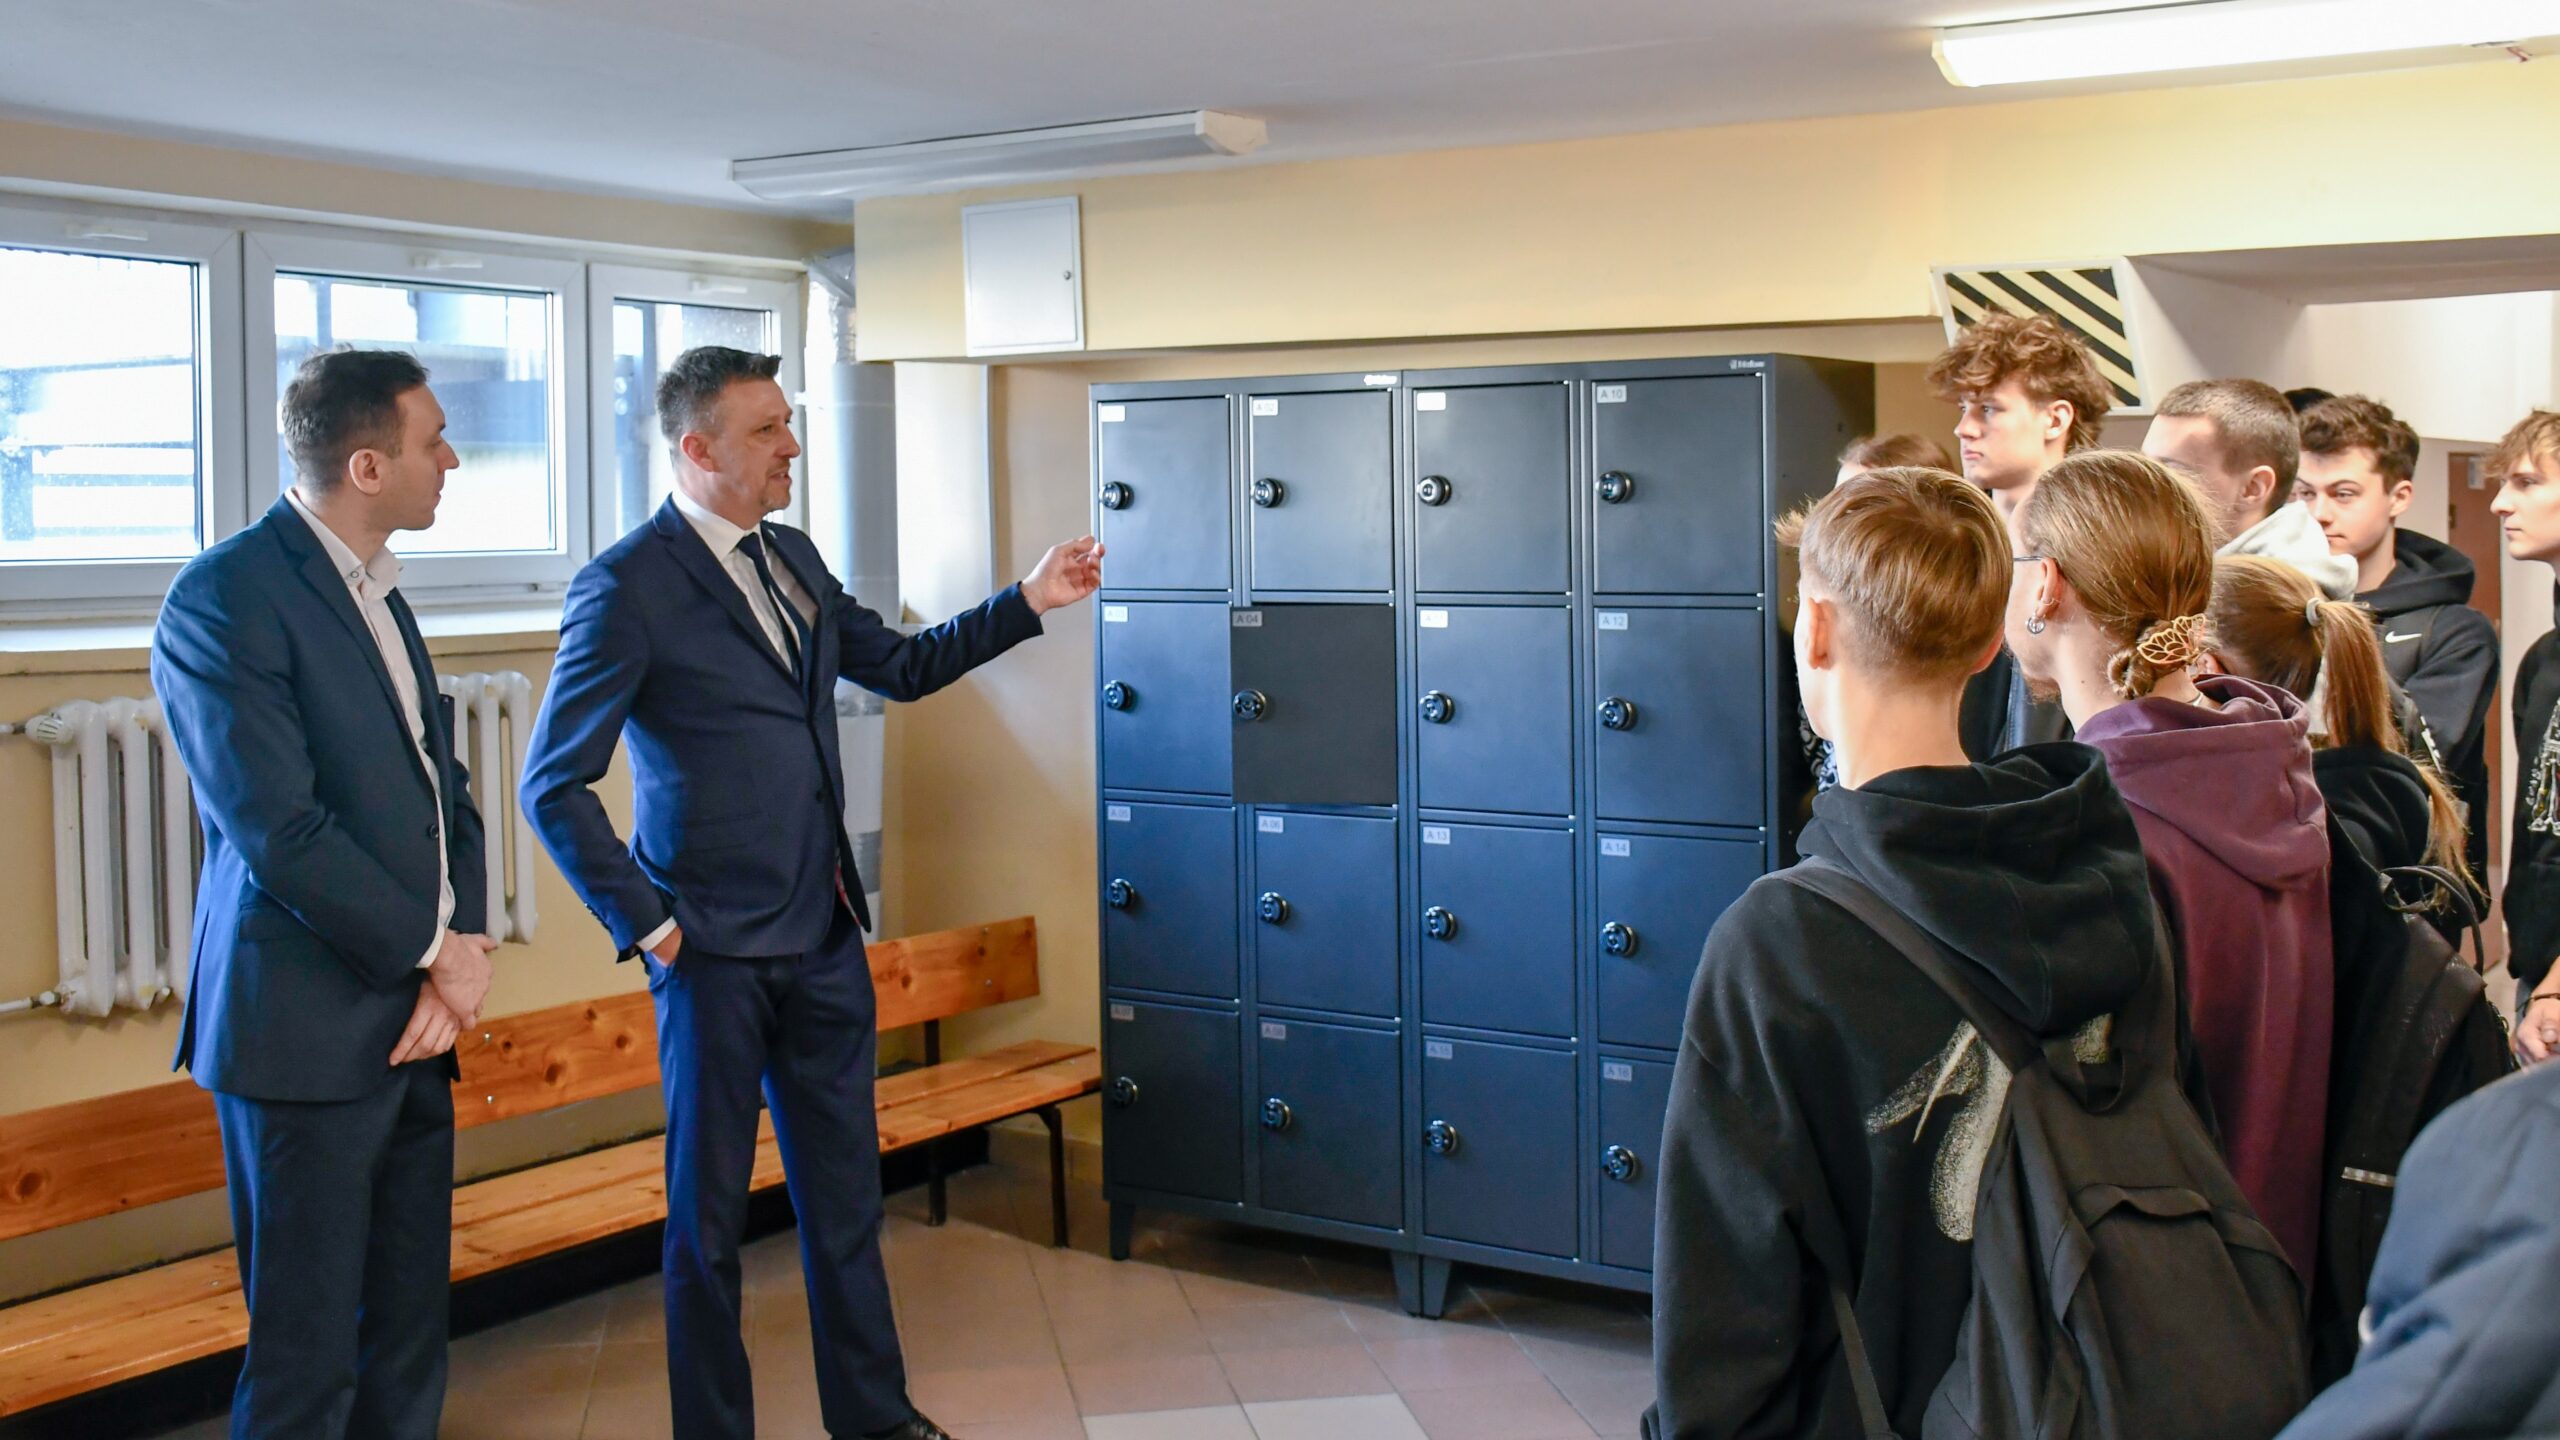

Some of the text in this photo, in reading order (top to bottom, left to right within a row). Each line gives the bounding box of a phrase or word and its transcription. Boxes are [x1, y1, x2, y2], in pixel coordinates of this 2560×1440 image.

[1600, 389, 1622, 399] A 10
[1236, 614, 1258, 623] A 04
[1602, 616, 1624, 626] A 12
[1427, 830, 1447, 840] A 13
[1604, 842, 1626, 852] A 14
[1429, 1045, 1436, 1054] A
[1606, 1065, 1614, 1075] A
